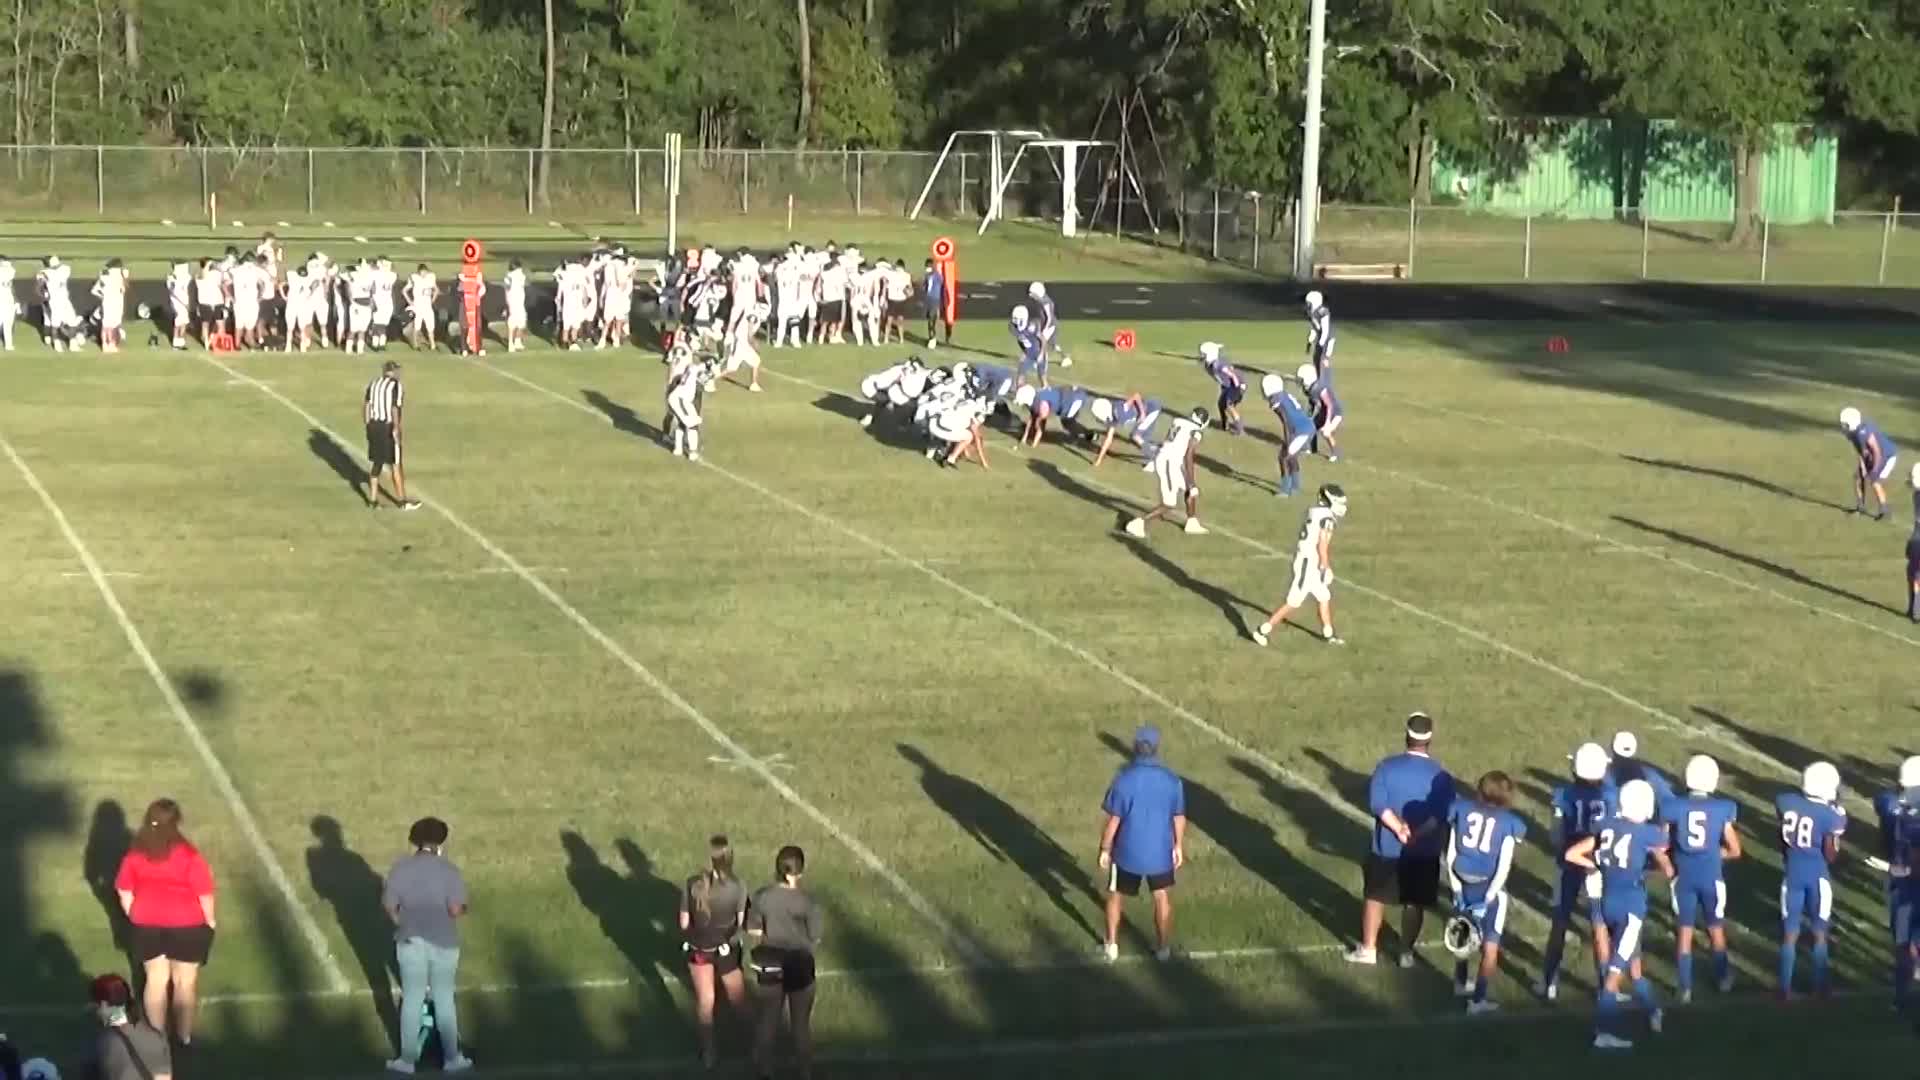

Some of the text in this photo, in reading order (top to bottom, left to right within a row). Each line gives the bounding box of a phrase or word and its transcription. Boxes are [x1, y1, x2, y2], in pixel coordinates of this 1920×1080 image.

[1116, 330, 1133, 349] 20
[1462, 811, 1497, 854] 31
[1594, 828, 1633, 870] 24
[1687, 810, 1707, 849] 5
[1782, 810, 1814, 849] 28
